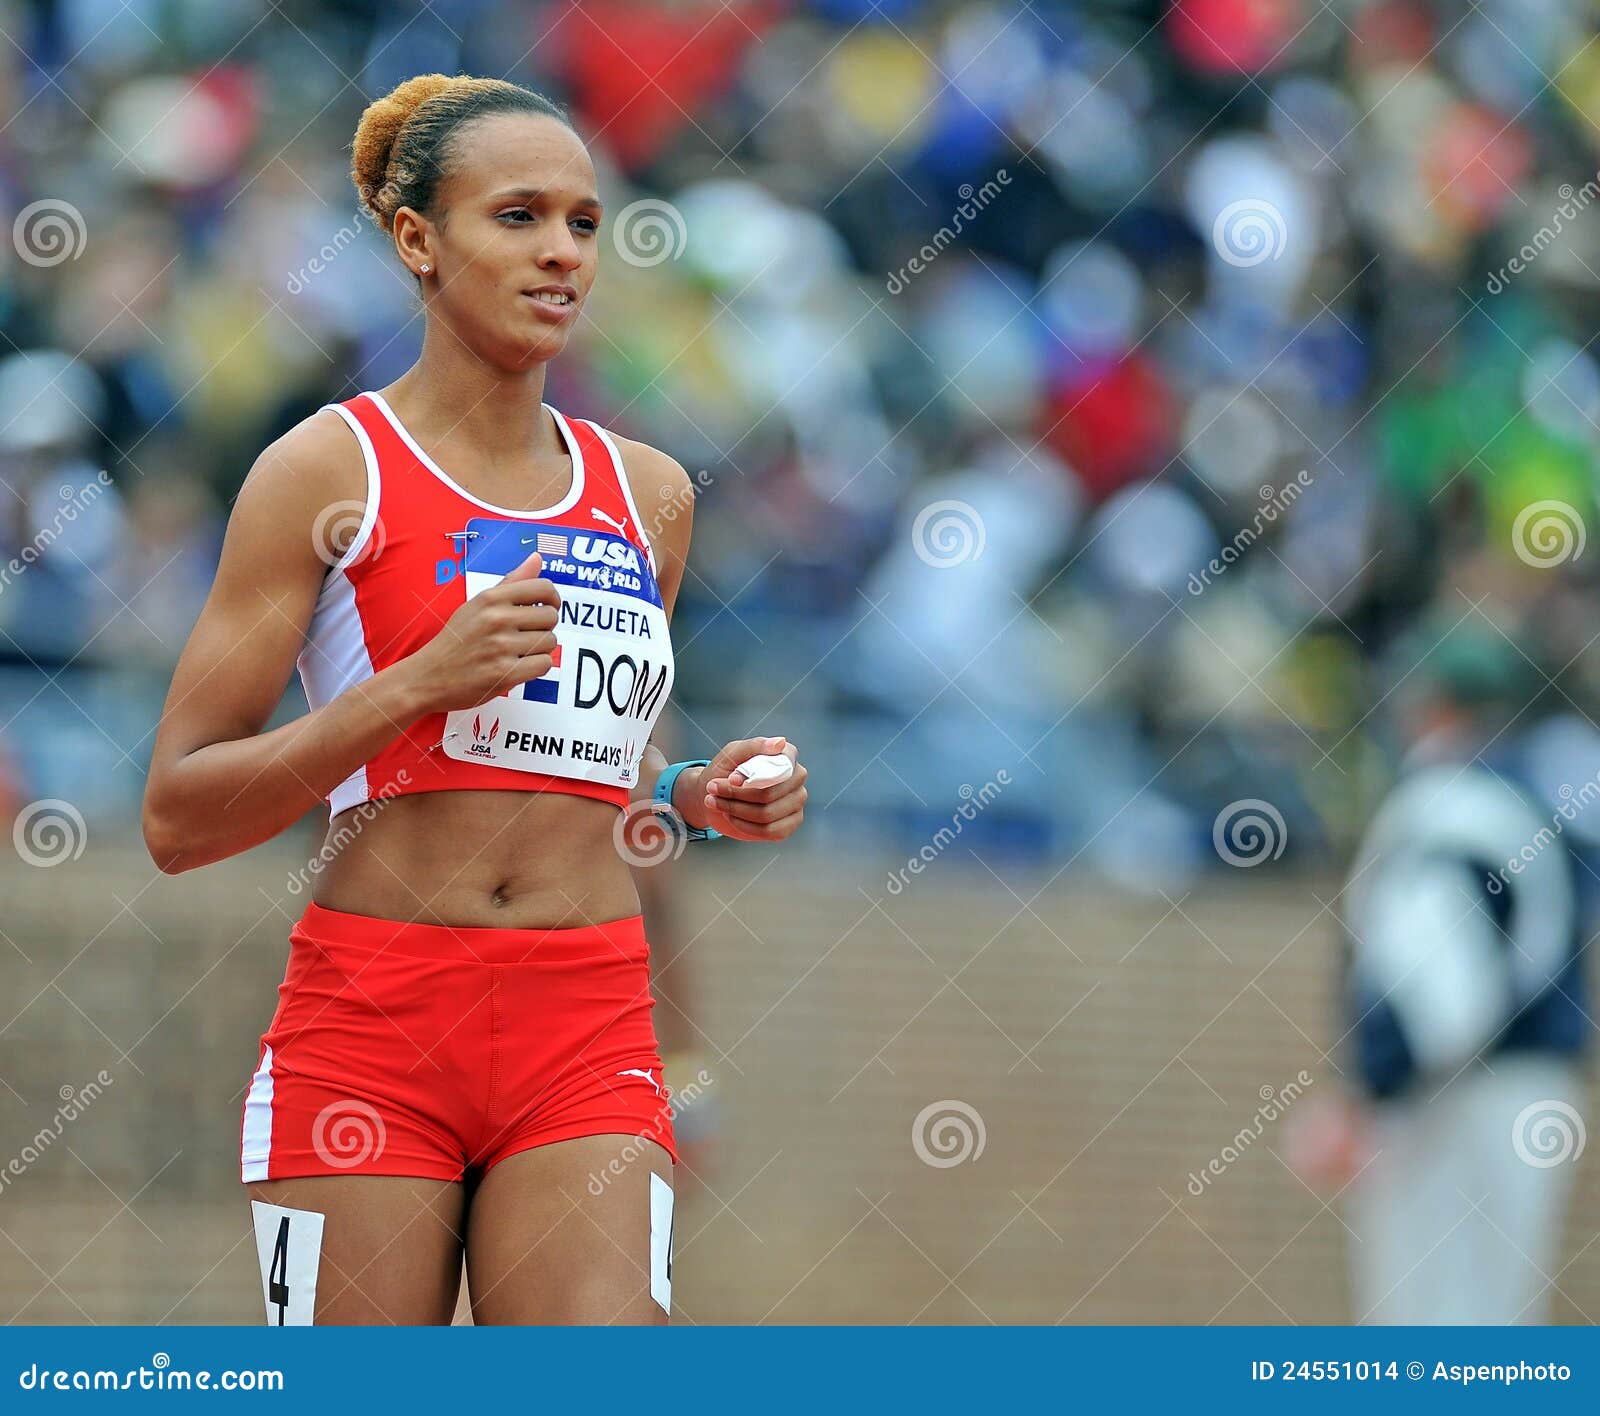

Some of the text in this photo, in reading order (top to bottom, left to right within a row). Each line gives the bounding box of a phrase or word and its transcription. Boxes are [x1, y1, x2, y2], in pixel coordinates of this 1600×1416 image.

[549, 559, 576, 574] the
[571, 535, 641, 575] USA
[561, 600, 651, 639] NZUETA
[574, 648, 667, 721] DOM
[471, 743, 491, 754] USA
[504, 730, 622, 767] PENN RELAYS
[269, 1216, 290, 1326] 4
